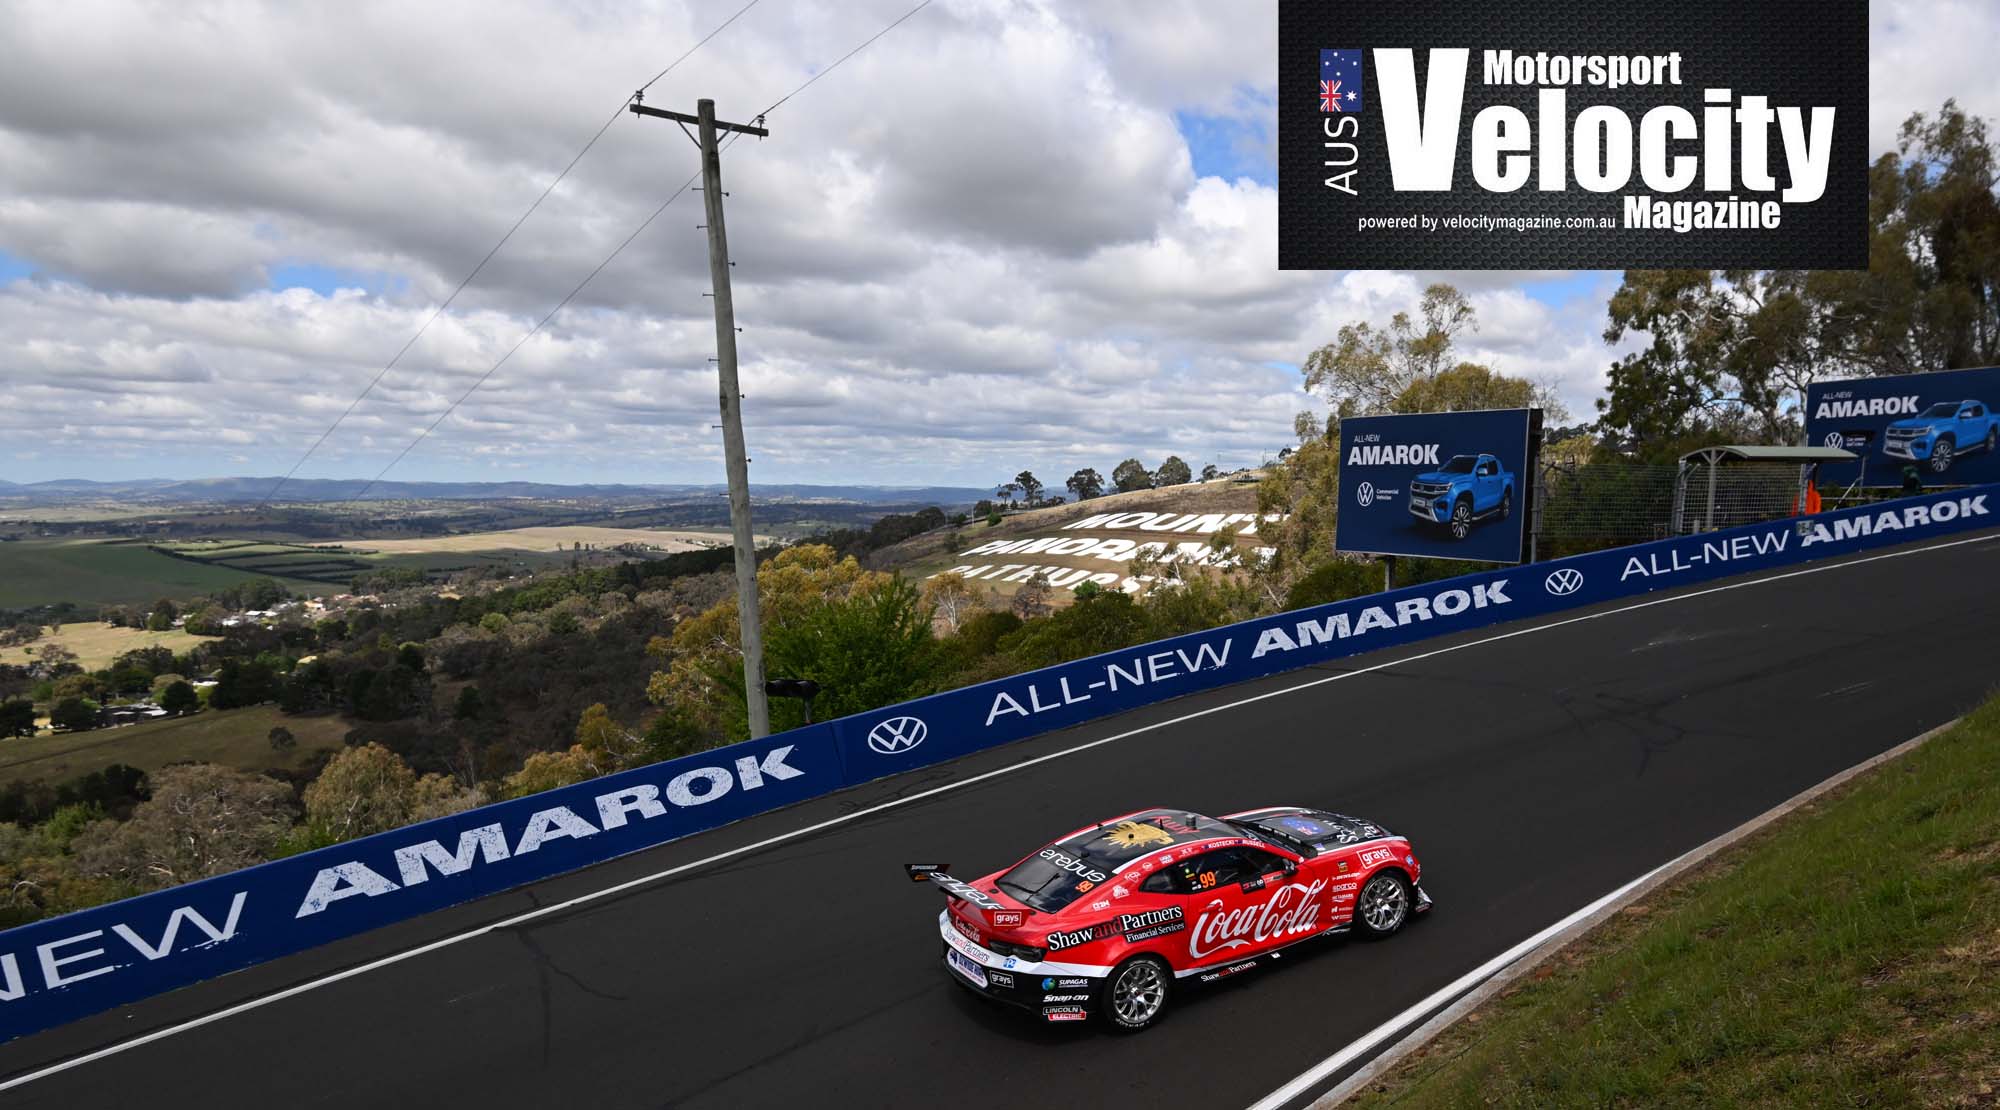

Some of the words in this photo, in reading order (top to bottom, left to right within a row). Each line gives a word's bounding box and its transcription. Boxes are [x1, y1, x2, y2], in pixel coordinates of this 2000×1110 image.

[1822, 391, 1852, 400] ALL-NEW
[1815, 395, 1919, 419] AMAROK
[1353, 434, 1380, 443] ALL-NEW
[1347, 444, 1440, 466] AMAROK
[1061, 511, 1290, 535] MOUNT
[295, 745, 805, 919] AMAROK
[985, 638, 1232, 726] ALL-NEW
[1251, 579, 1512, 659] AMAROK
[1620, 530, 1790, 581] ALL-NEW
[1801, 494, 1990, 547] AMAROK
[1361, 848, 1391, 865] grays
[1040, 849, 1106, 882] erebus
[1200, 871, 1217, 889] 99
[996, 914, 1019, 924] grays
[1126, 928, 1158, 943] Financial
[1158, 921, 1185, 935] Services
[991, 973, 1012, 985] grays
[1043, 994, 1090, 1003] Snap-on
[1045, 1006, 1080, 1014] LINCOLN
